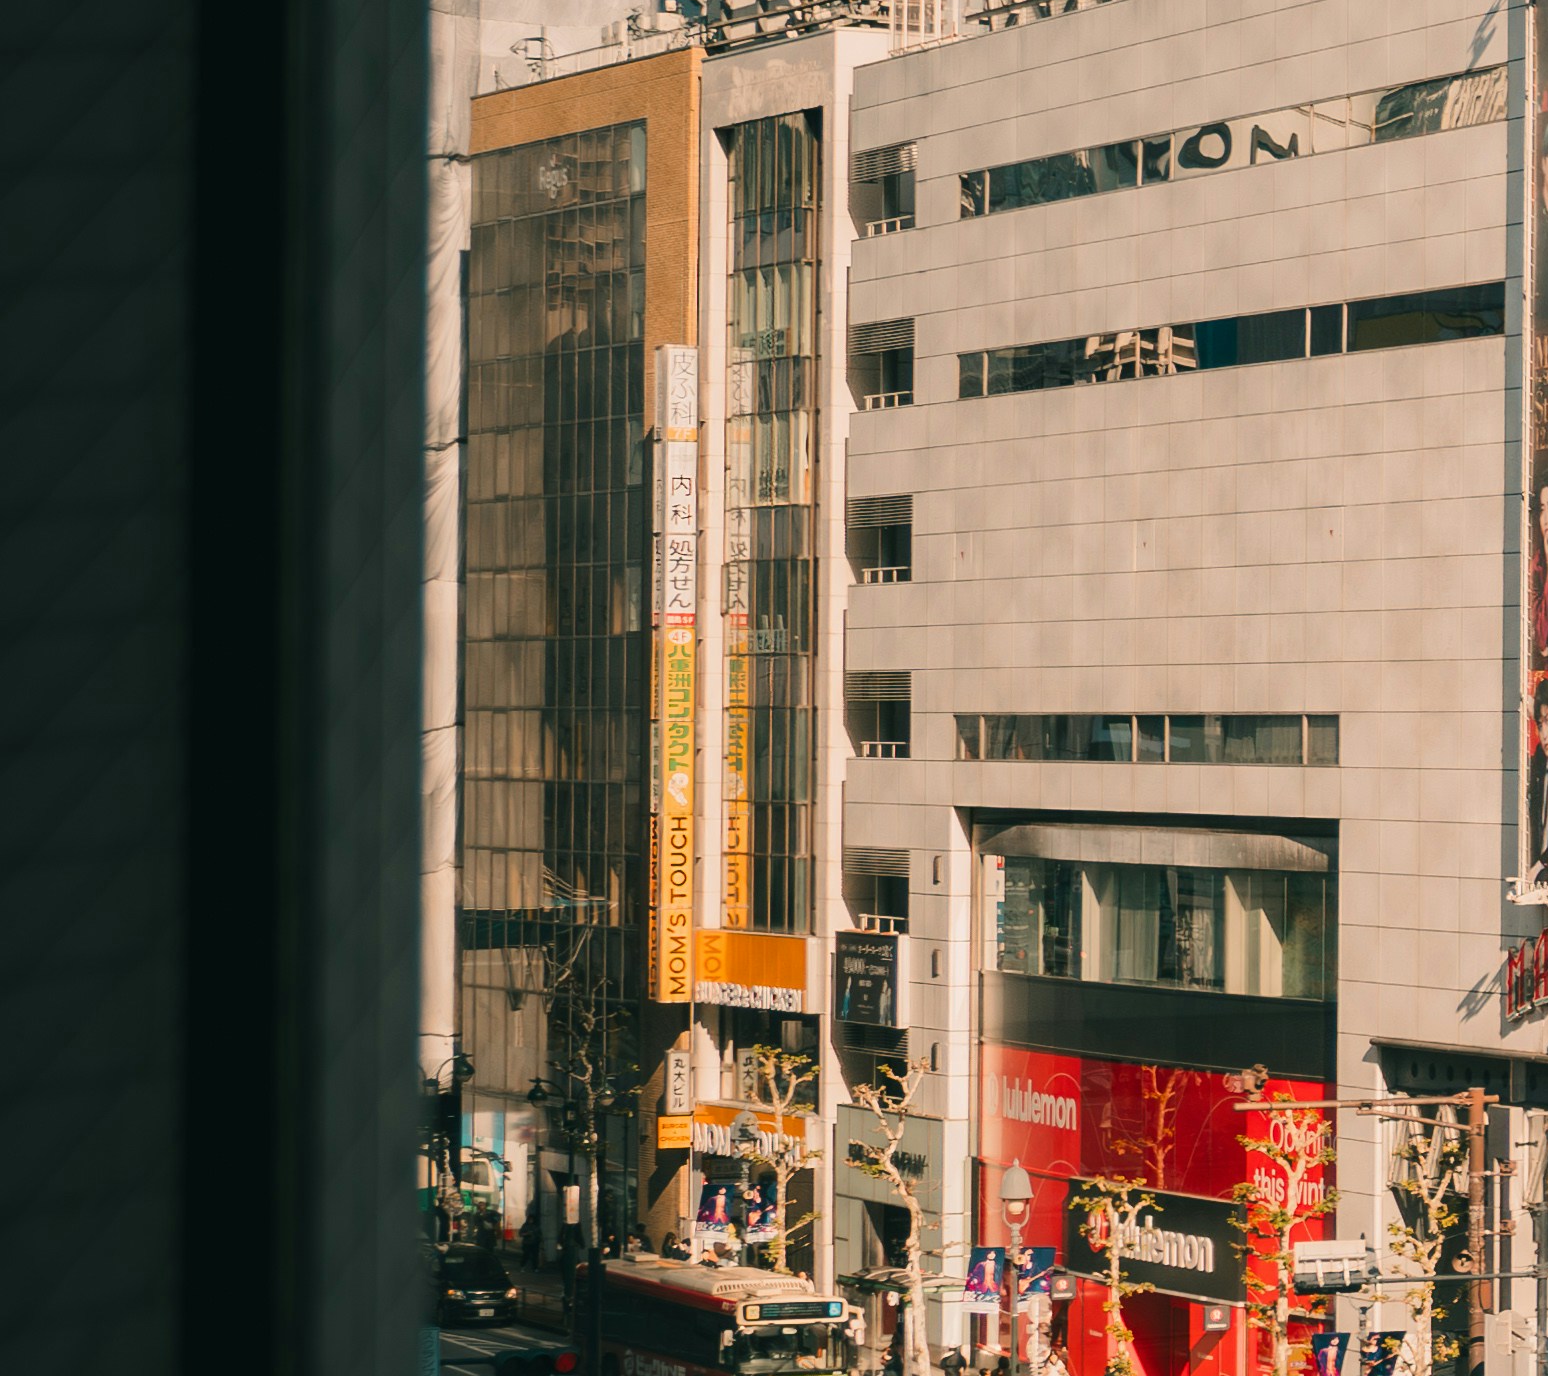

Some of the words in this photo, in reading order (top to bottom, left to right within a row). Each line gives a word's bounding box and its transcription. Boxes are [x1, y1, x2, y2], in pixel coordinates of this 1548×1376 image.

[671, 352, 695, 425] 皮ふ科
[671, 475, 692, 525] 内科
[669, 539, 693, 609] 処方せん
[672, 632, 687, 642] 4F
[668, 645, 691, 772] 八重洲コンタクト
[670, 816, 688, 903] TOUCH
[669, 913, 687, 995] MOM'S
[673, 1058, 685, 1108] 丸大ビル
[1002, 1075, 1077, 1131] lululemon
